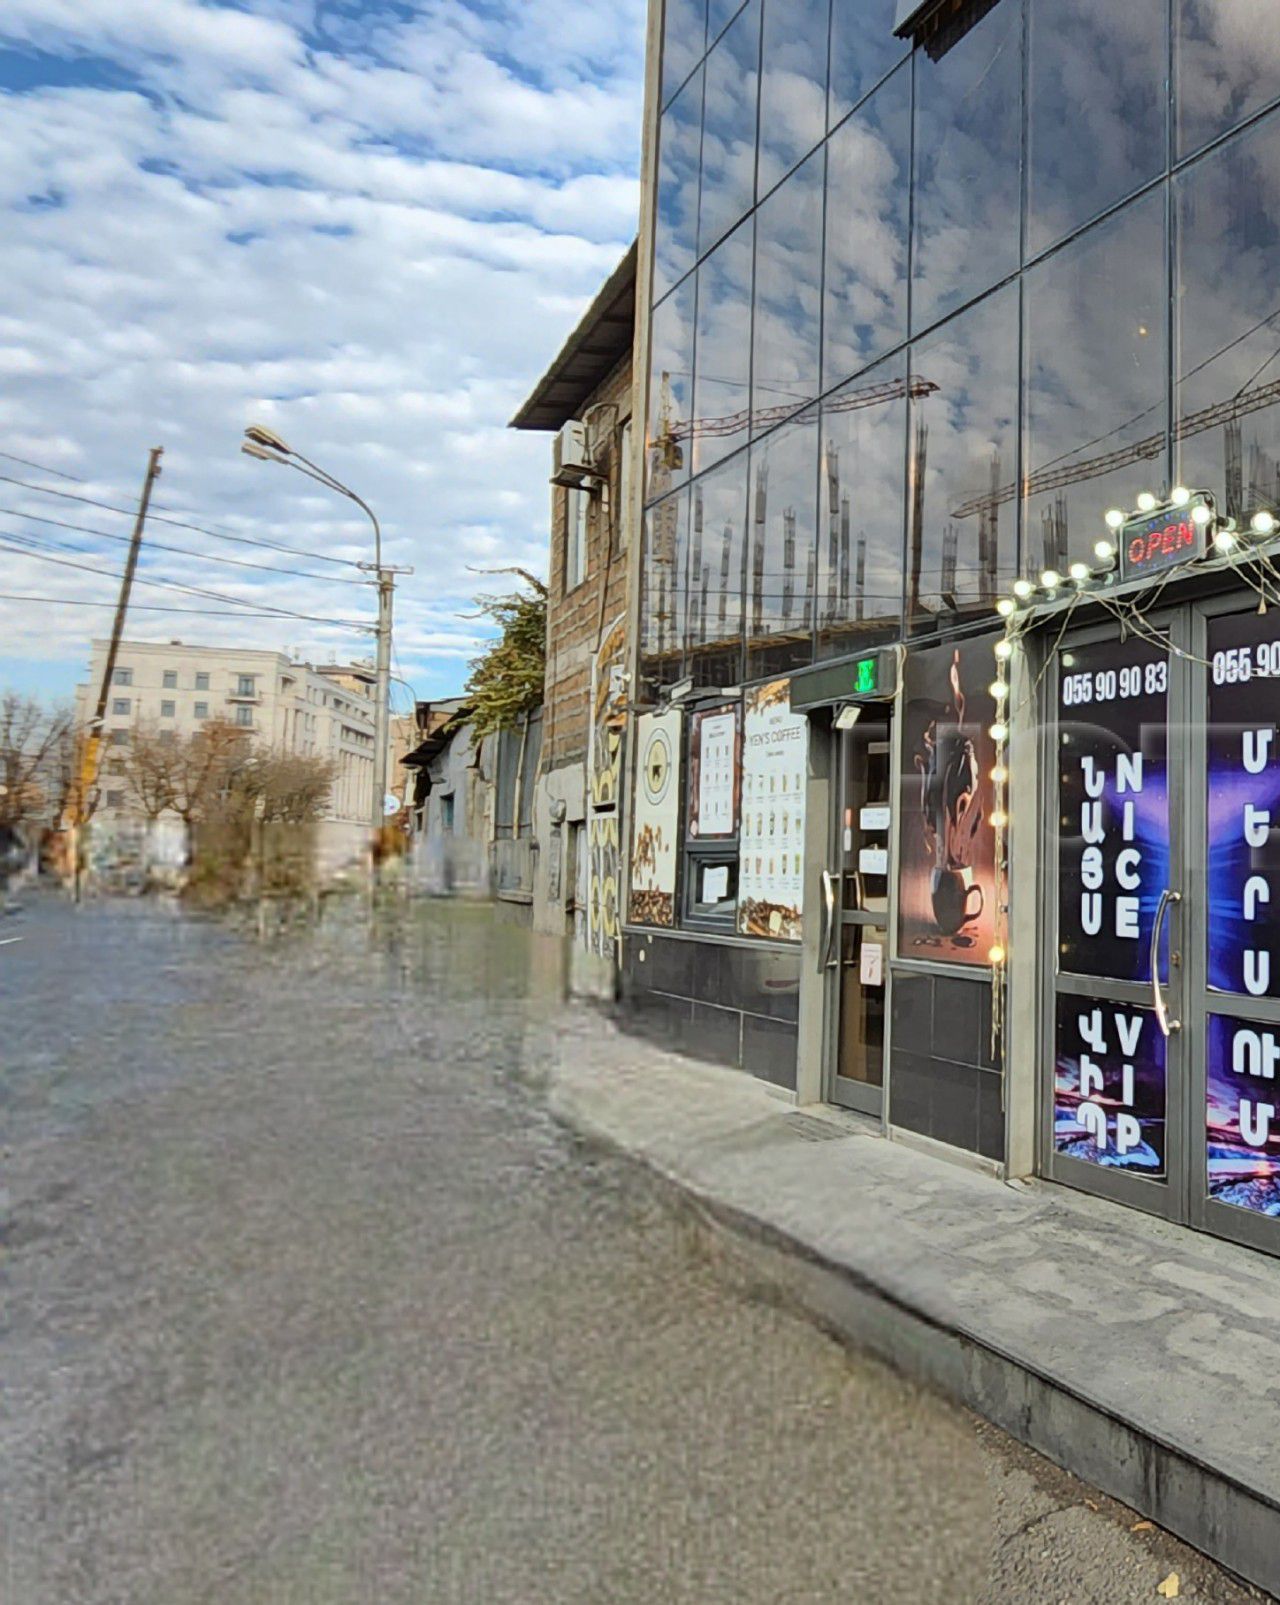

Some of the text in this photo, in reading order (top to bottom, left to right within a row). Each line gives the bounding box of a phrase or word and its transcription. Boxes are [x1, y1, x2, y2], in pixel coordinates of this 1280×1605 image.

[1128, 519, 1195, 563] OPEN
[1062, 661, 1167, 706] 055 90 90 83
[1212, 646, 1252, 686] 055
[771, 726, 802, 743] COFFEE
[1076, 755, 1108, 1150] ՆԱՅՍ ՎԻՊ
[1114, 751, 1144, 1155] NICE VIP
